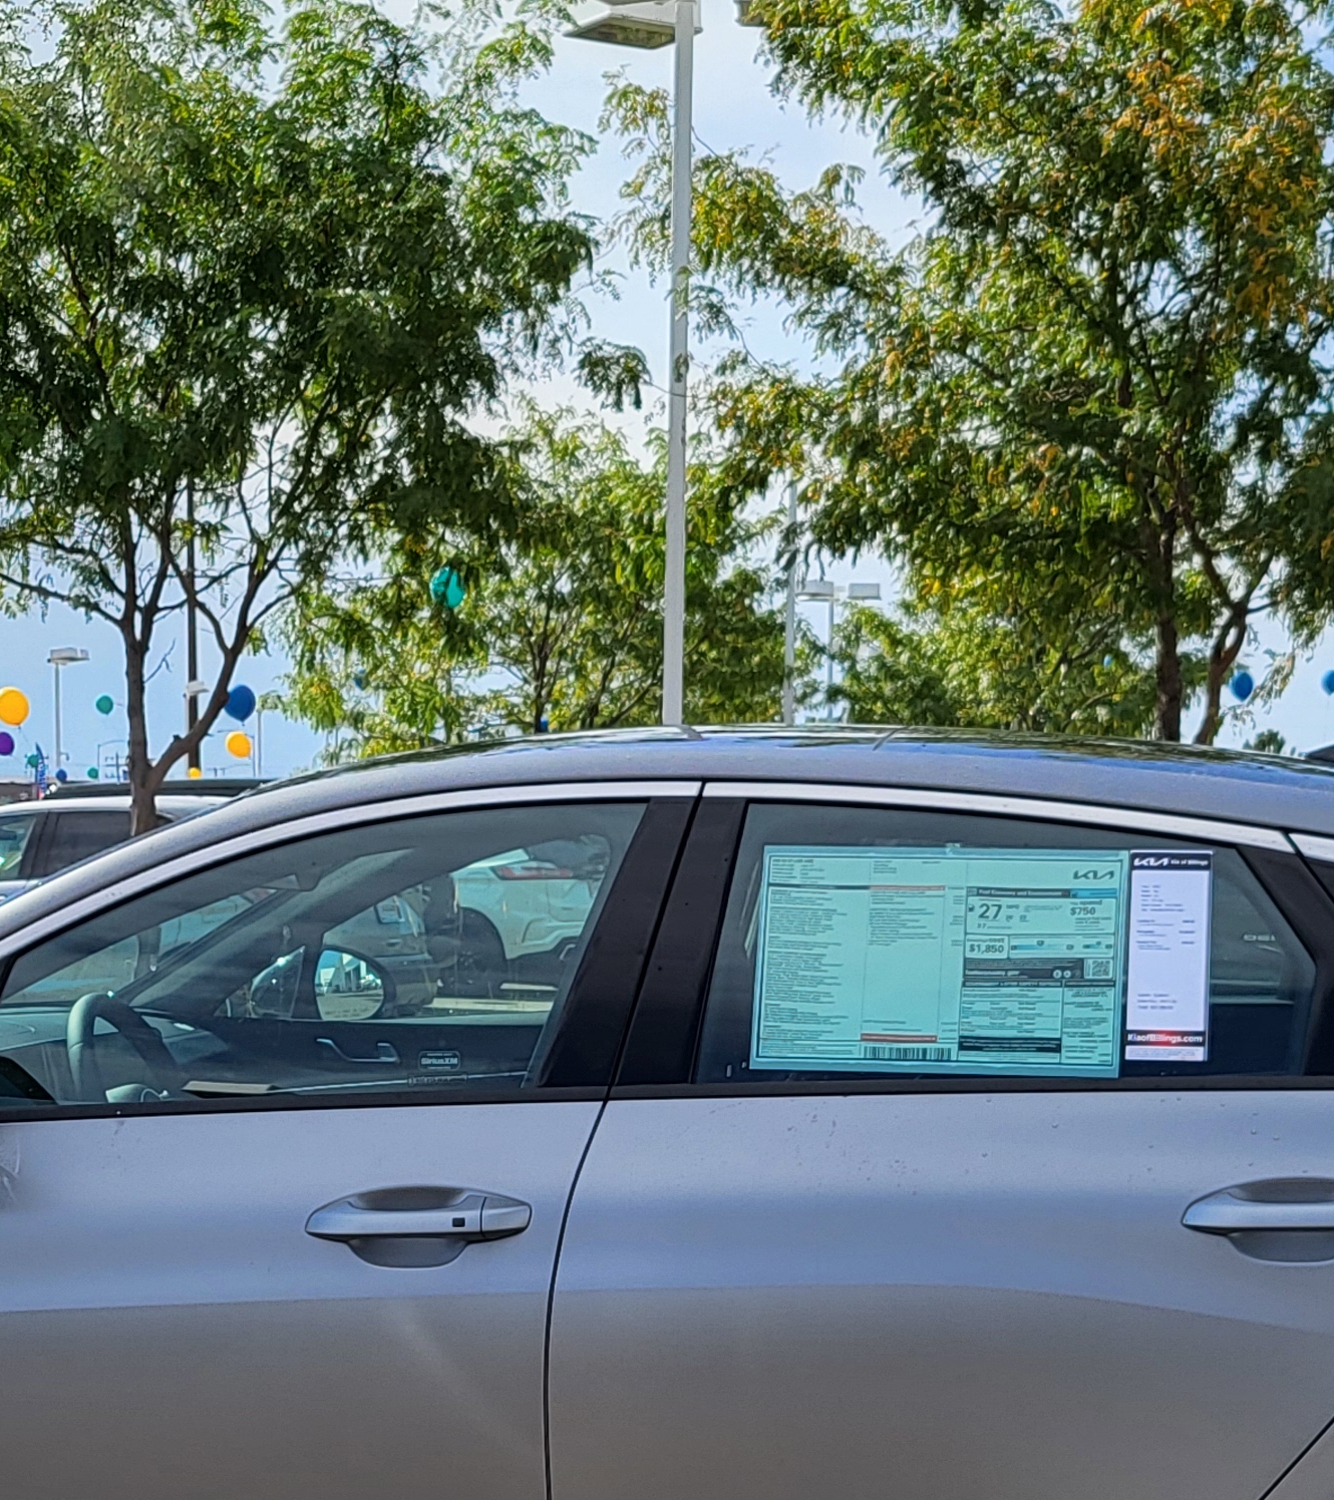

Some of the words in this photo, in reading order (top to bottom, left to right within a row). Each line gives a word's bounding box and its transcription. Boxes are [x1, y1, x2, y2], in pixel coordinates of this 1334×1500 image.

[1133, 857, 1169, 867] KIA
[1072, 869, 1115, 881] KIA
[978, 902, 1003, 920] 27
[1070, 906, 1096, 916] $750
[969, 943, 1005, 955] $1,850
